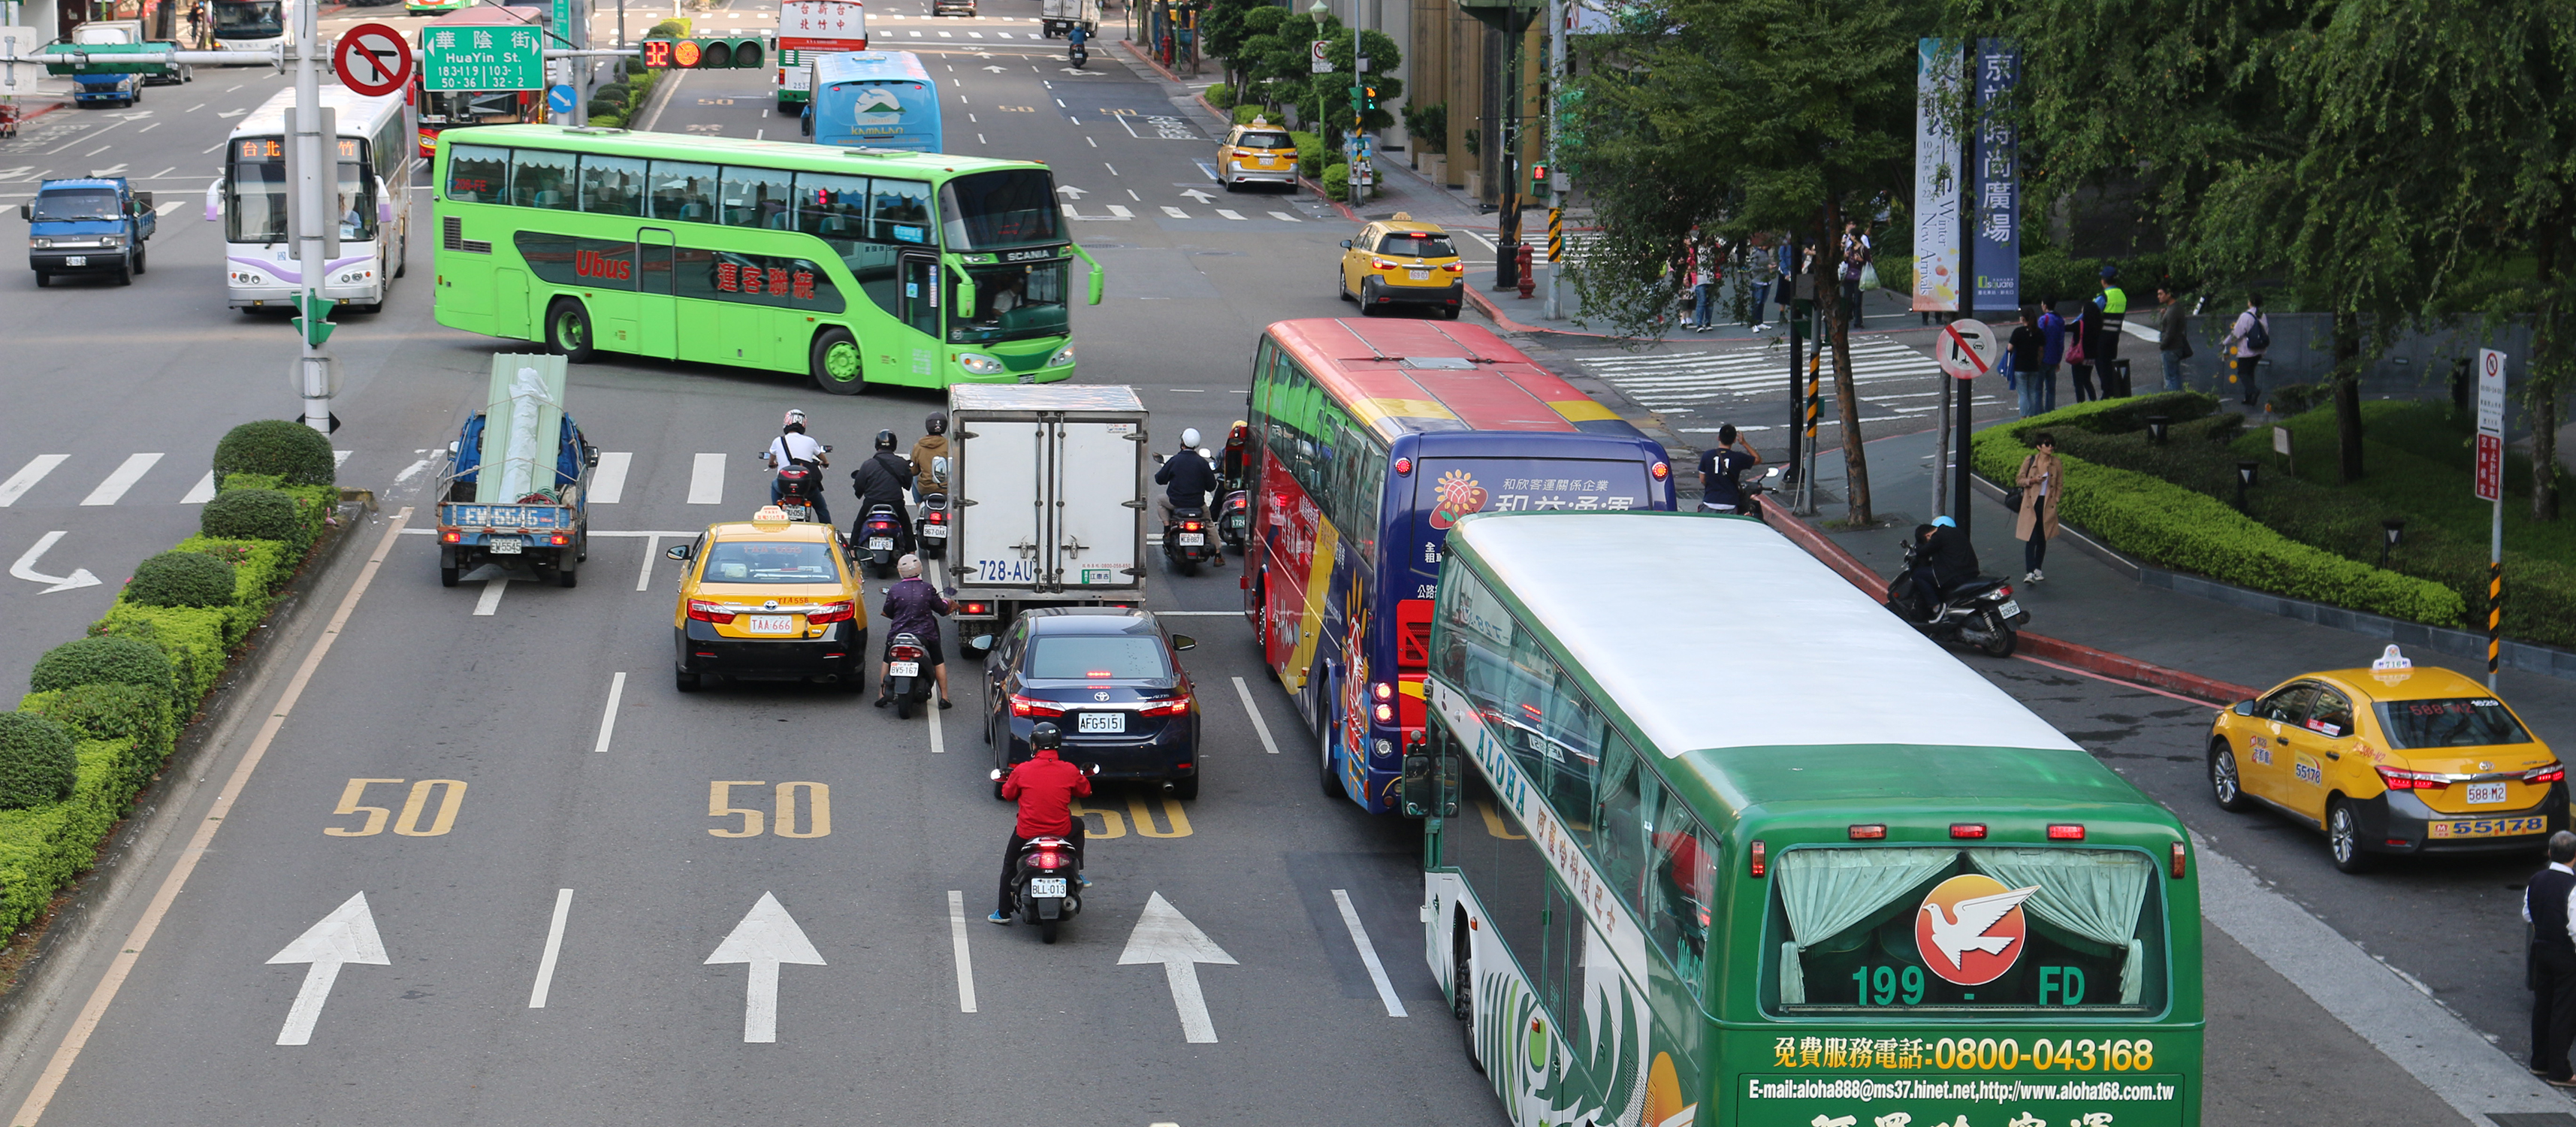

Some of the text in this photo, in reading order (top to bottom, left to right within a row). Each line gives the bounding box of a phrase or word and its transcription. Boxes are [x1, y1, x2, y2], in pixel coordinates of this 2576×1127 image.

[445, 53, 521, 63] HuaYin St.
[646, 41, 670, 66] 32
[438, 66, 479, 77] 183-119
[242, 140, 281, 157] 台北
[1937, 199, 1955, 247] Winter
[1007, 249, 1050, 261] SCANIA
[1919, 212, 1937, 296] New Arrivals
[575, 249, 631, 281] Ubus
[1502, 478, 1609, 492] 和欣客運關係企業
[466, 508, 539, 525] EW-5545
[491, 542, 522, 552] EW-5545
[979, 560, 1033, 582] 728-AU
[1418, 585, 1437, 599] 公路
[752, 620, 790, 630] TAA-666
[891, 666, 917, 675] BV5-167
[1080, 717, 1123, 730] AFG-5151
[1475, 727, 1527, 818] ALOHA
[2296, 763, 2321, 784] 55178
[2469, 787, 2505, 802] 588-M2
[323, 778, 468, 838] 50
[707, 780, 832, 838] 50
[2453, 817, 2543, 834] 55178
[1032, 884, 1065, 895] BLL-013
[1852, 965, 1925, 1005] 199
[2038, 966, 2085, 1006] FD
